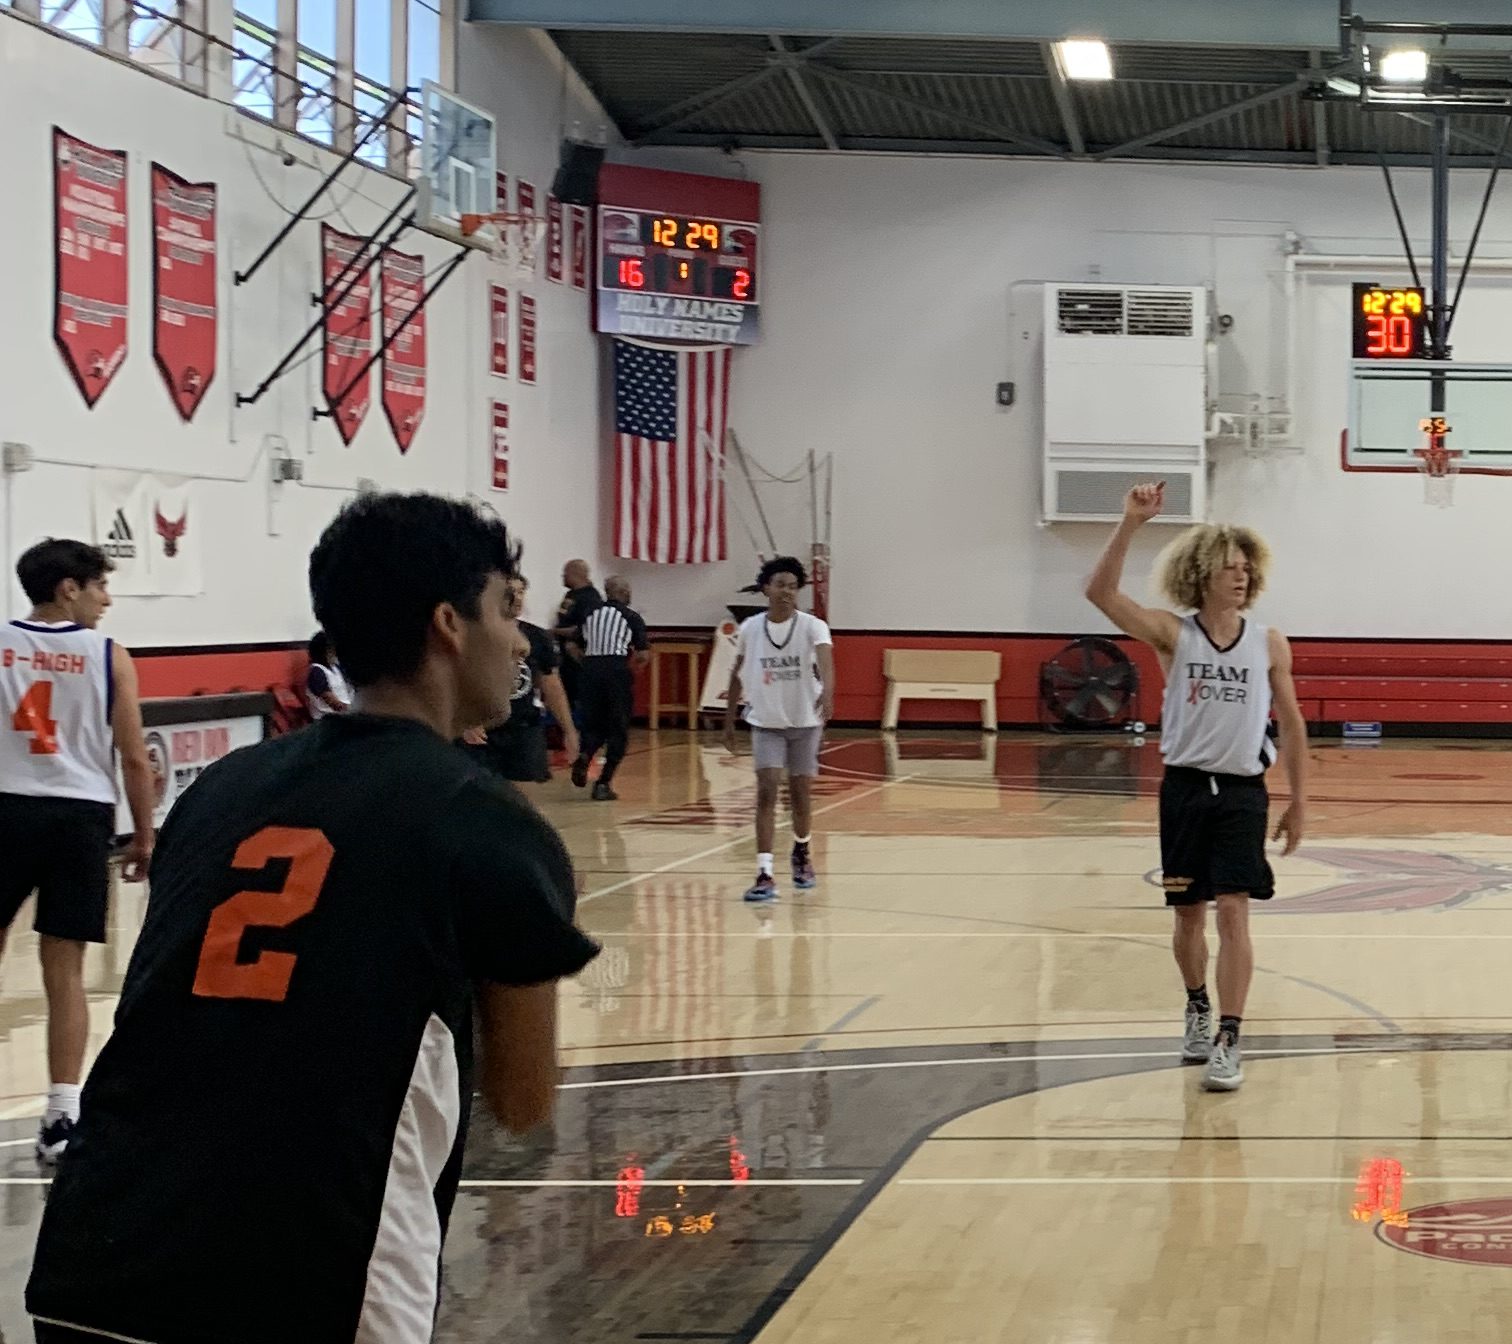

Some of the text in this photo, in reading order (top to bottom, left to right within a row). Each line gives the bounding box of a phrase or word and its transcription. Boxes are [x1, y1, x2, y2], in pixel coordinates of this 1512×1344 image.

[619, 260, 644, 287] 16
[733, 271, 750, 297] 2
[616, 292, 745, 323] HOLY NAMES
[1363, 291, 1421, 314] 12:29
[618, 315, 741, 343] UNIVERSITY
[1367, 315, 1410, 353] 30
[760, 656, 800, 668] TEAM
[1186, 662, 1249, 684] TEAM
[12, 680, 58, 754] 4
[192, 825, 337, 1003] 2
